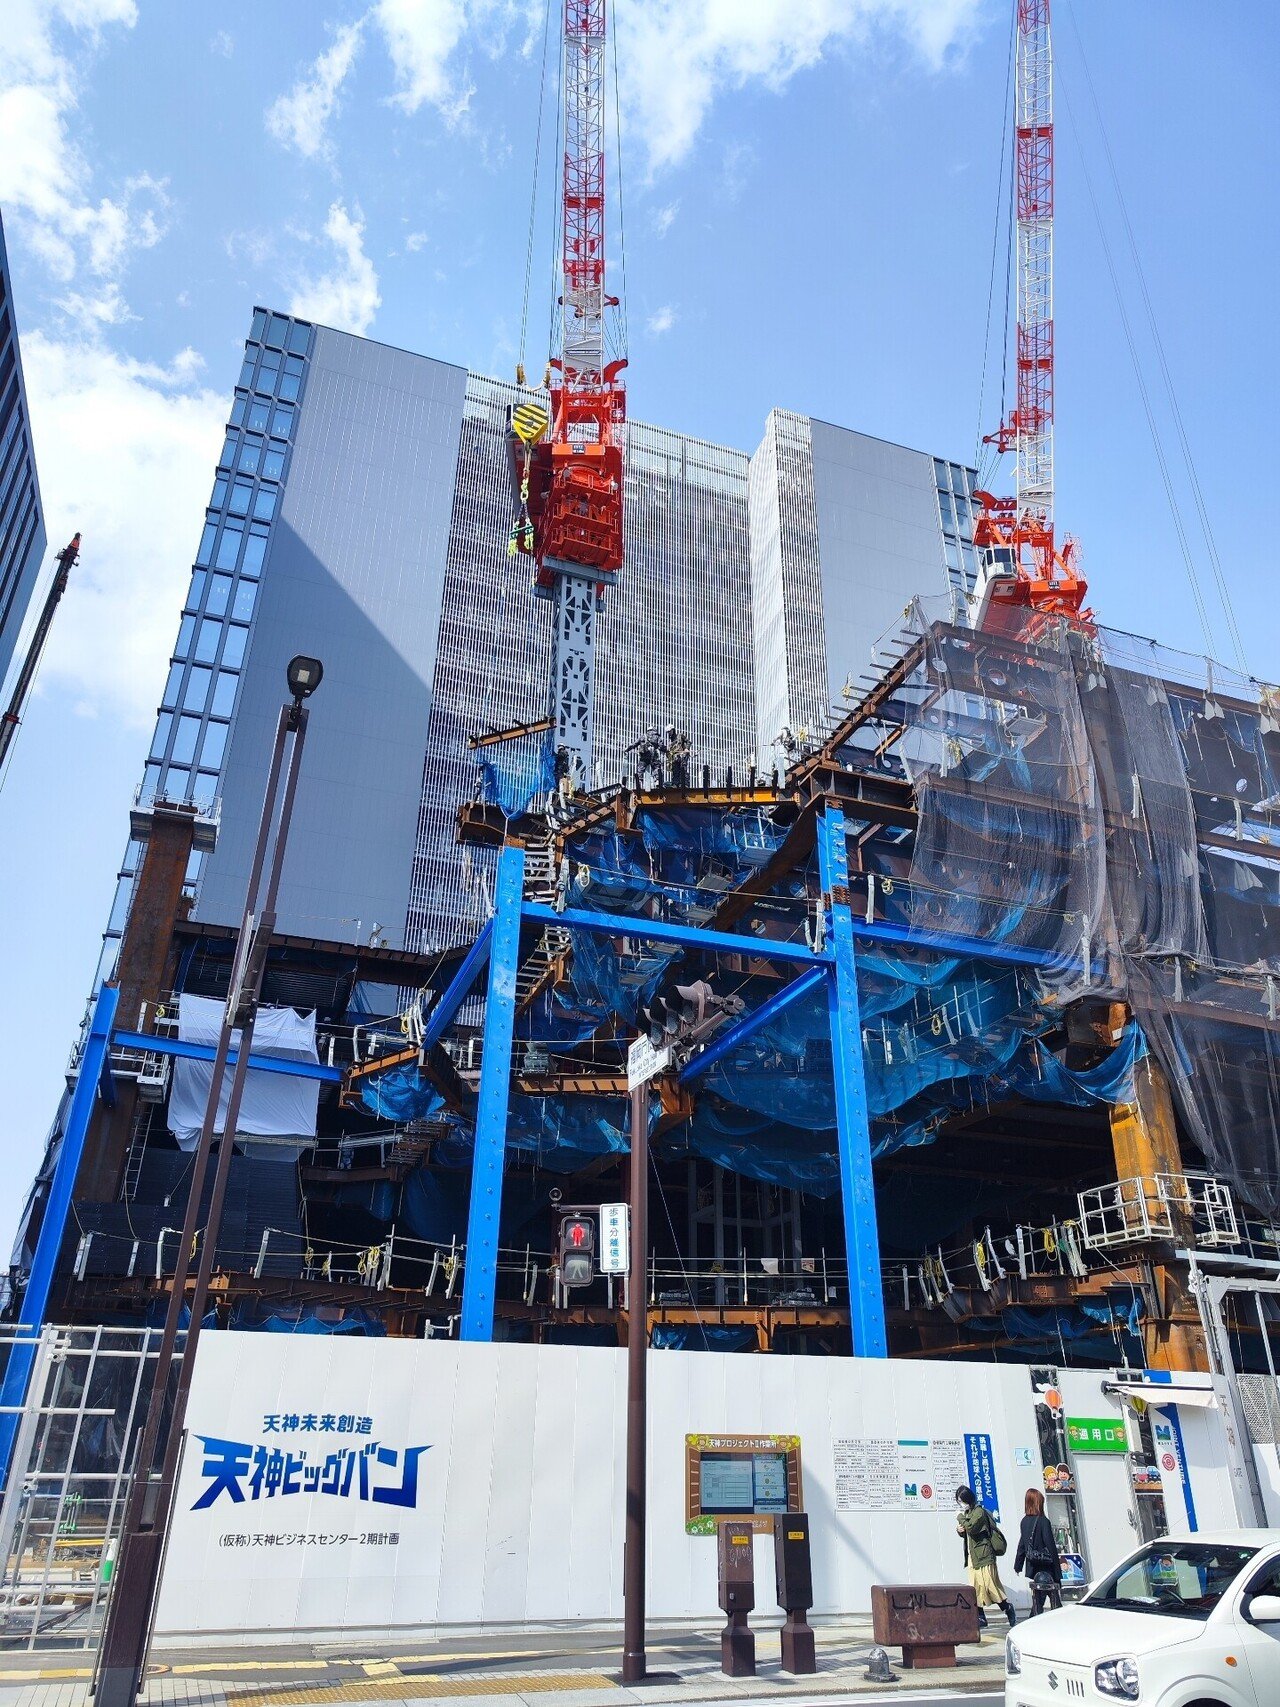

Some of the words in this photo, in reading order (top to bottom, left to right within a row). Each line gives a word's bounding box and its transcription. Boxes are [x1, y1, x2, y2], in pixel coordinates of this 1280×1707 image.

[609, 1207, 619, 1268] 歩車分離信号
[262, 1413, 373, 1434] 天神未来創造
[1079, 1428, 1115, 1441] 通用口
[190, 1434, 434, 1511] 天神ビッグバン
